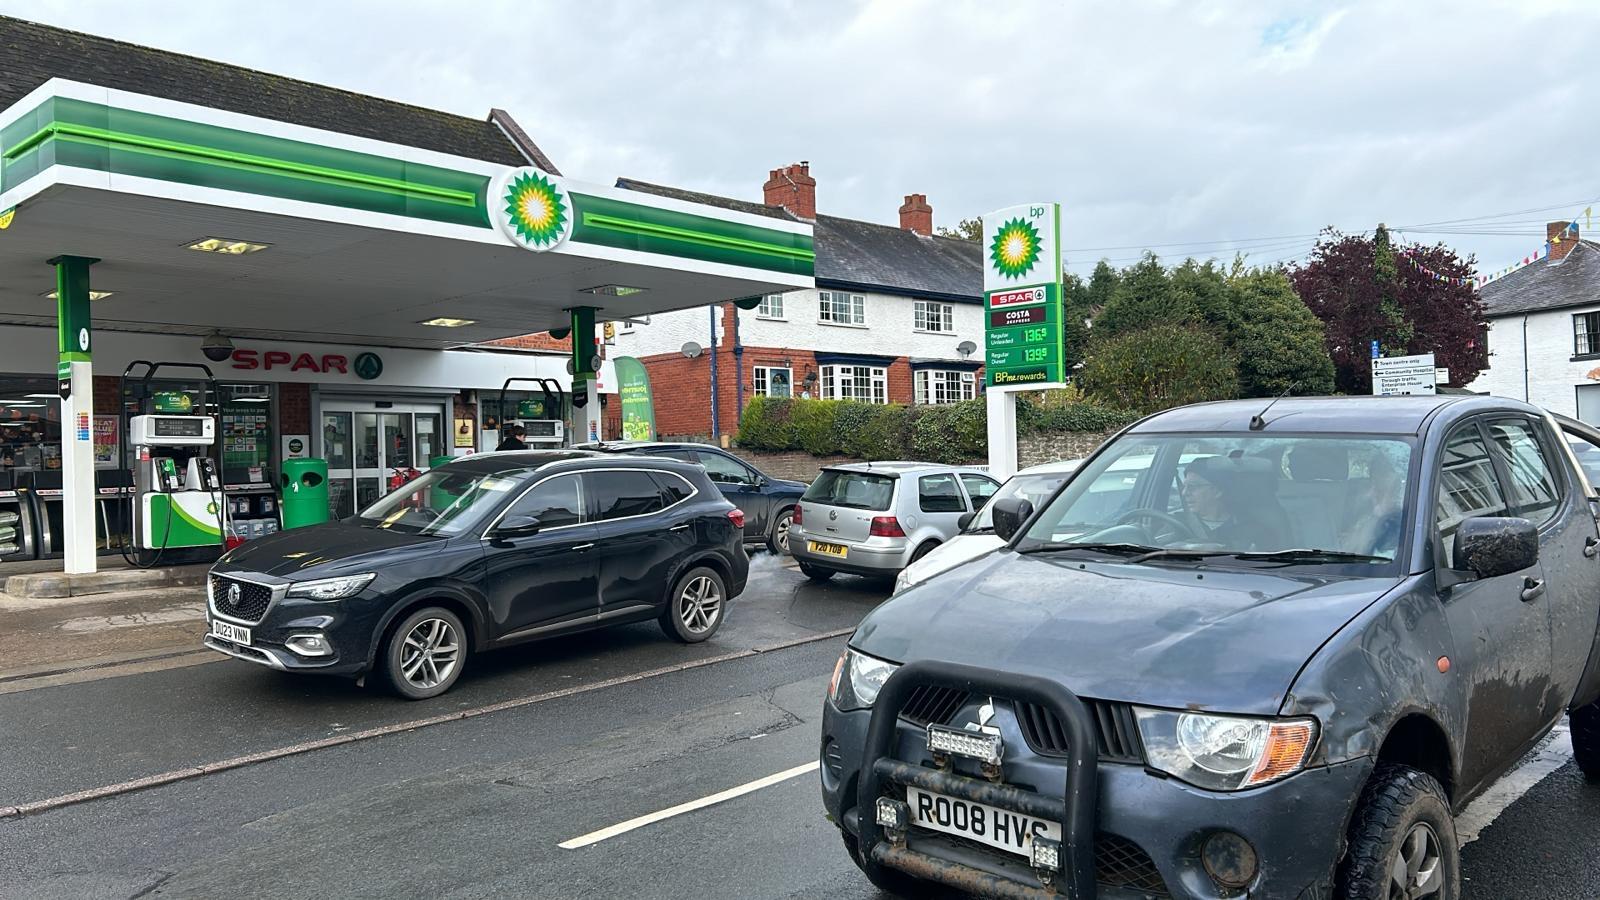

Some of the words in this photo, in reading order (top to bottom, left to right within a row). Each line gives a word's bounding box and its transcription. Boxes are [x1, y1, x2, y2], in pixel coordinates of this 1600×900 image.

[1030, 206, 1044, 219] bp
[1000, 292, 1033, 304] SPAR
[1006, 310, 1030, 319] COSTA
[990, 338, 1014, 346] Unleaded
[231, 349, 348, 374] SPAR
[215, 622, 232, 638] DU23
[233, 627, 248, 642] VNN
